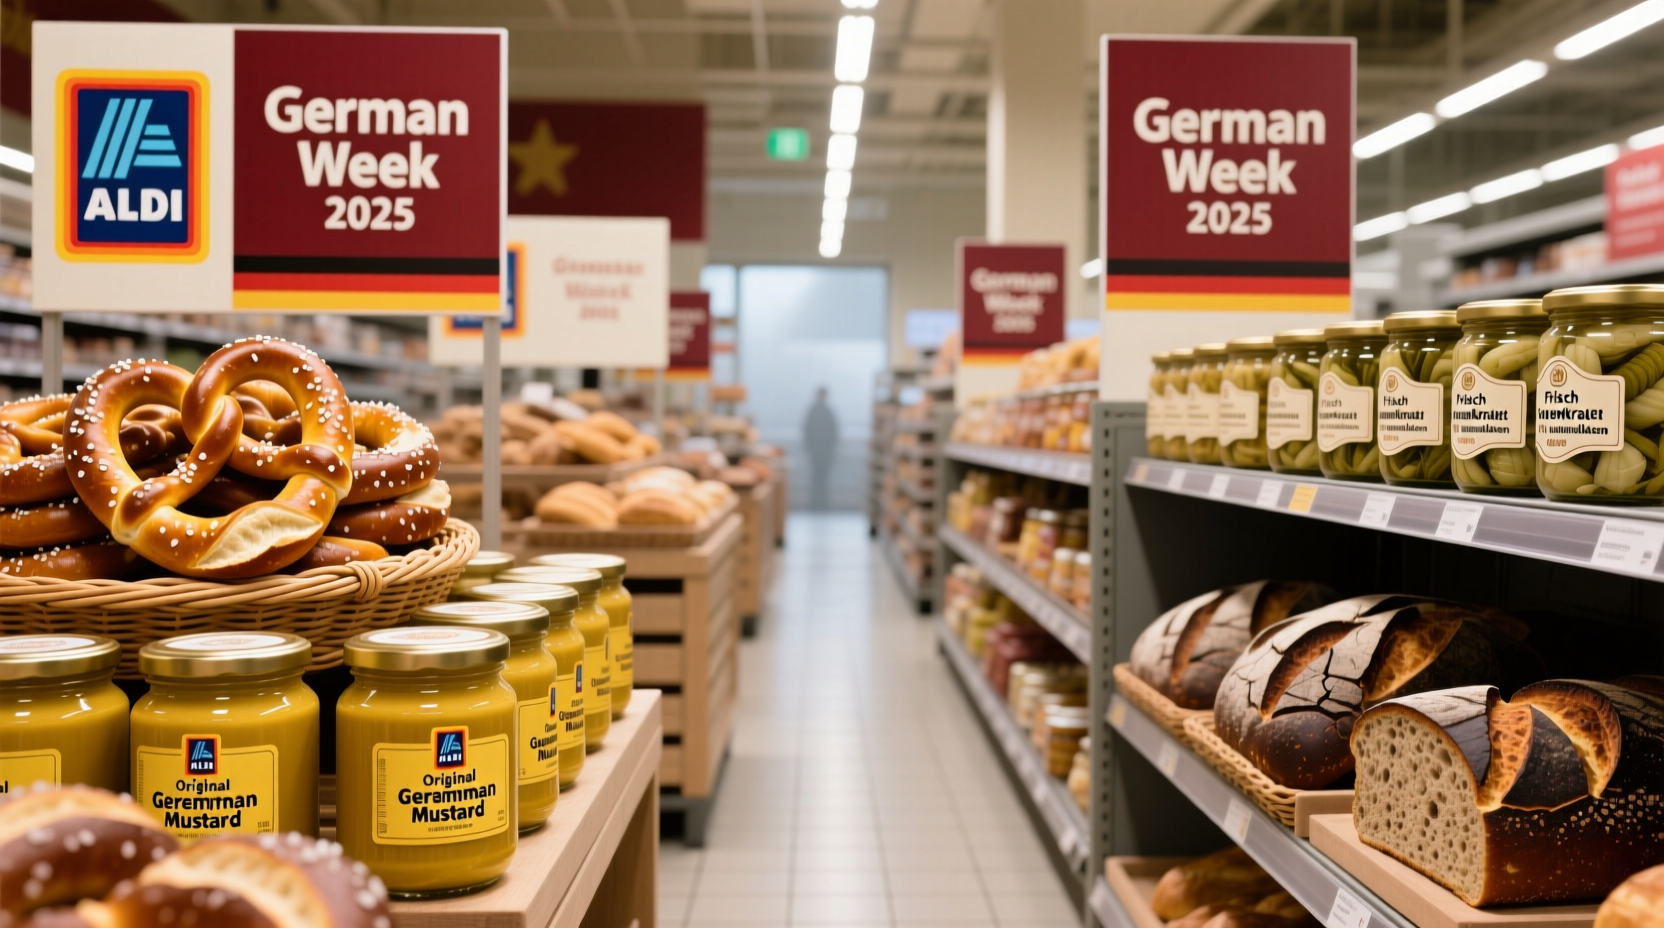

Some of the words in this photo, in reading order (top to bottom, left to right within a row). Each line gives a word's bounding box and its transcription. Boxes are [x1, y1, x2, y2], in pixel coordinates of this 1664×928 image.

[264, 85, 469, 136] German
[1133, 97, 1326, 145] German
[297, 140, 440, 190] Week
[1161, 148, 1297, 195] Week
[83, 188, 183, 222] ALDI
[324, 196, 416, 231] 2025
[1186, 201, 1273, 235] 2025
[175, 779, 230, 795] Original
[422, 768, 476, 789] Original
[164, 810, 242, 829] Mustard
[411, 799, 485, 824] Mustard
